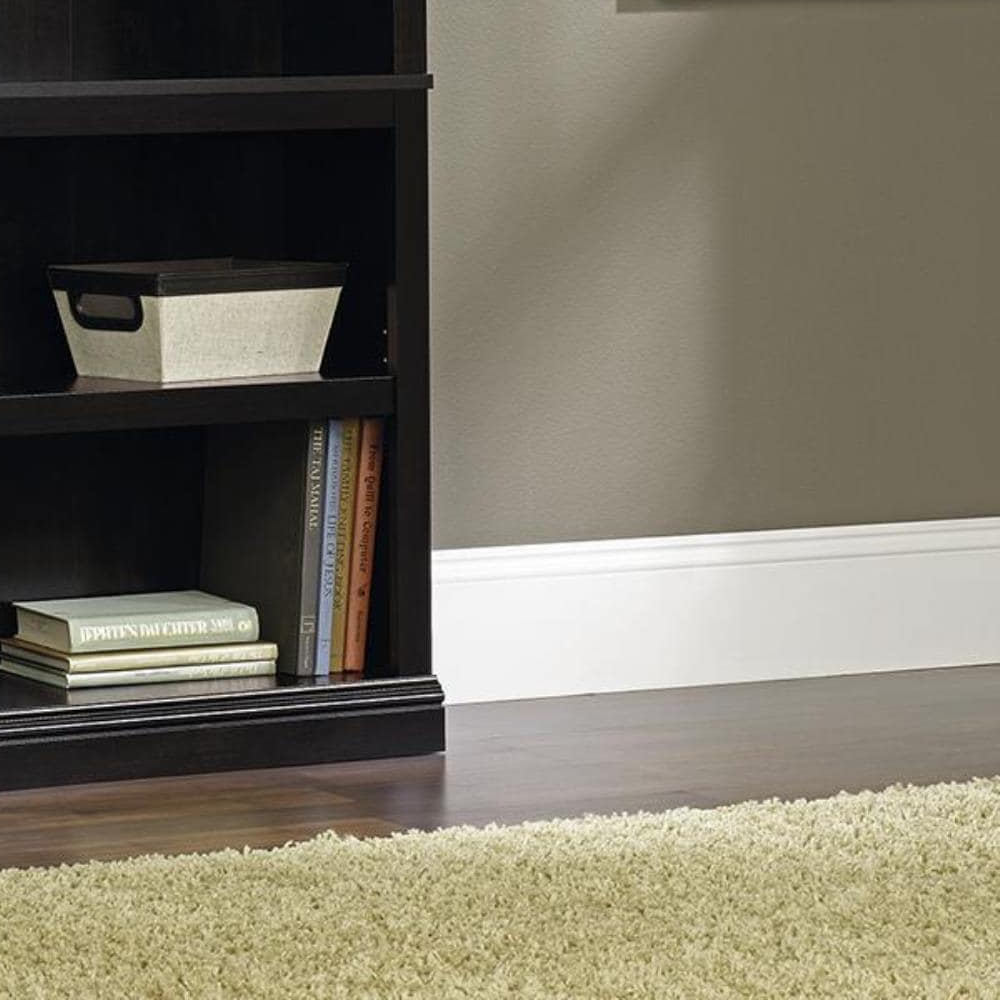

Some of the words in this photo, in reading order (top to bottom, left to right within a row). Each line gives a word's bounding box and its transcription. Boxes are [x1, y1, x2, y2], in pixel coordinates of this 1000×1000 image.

[312, 429, 323, 456] THE
[310, 459, 321, 481] TAJ
[367, 444, 377, 471] From
[364, 475, 376, 501] Quill
[308, 482, 320, 530] MAHAL
[326, 515, 337, 536] LIFE
[360, 520, 371, 571] Computer
[323, 563, 335, 598] JESUS
